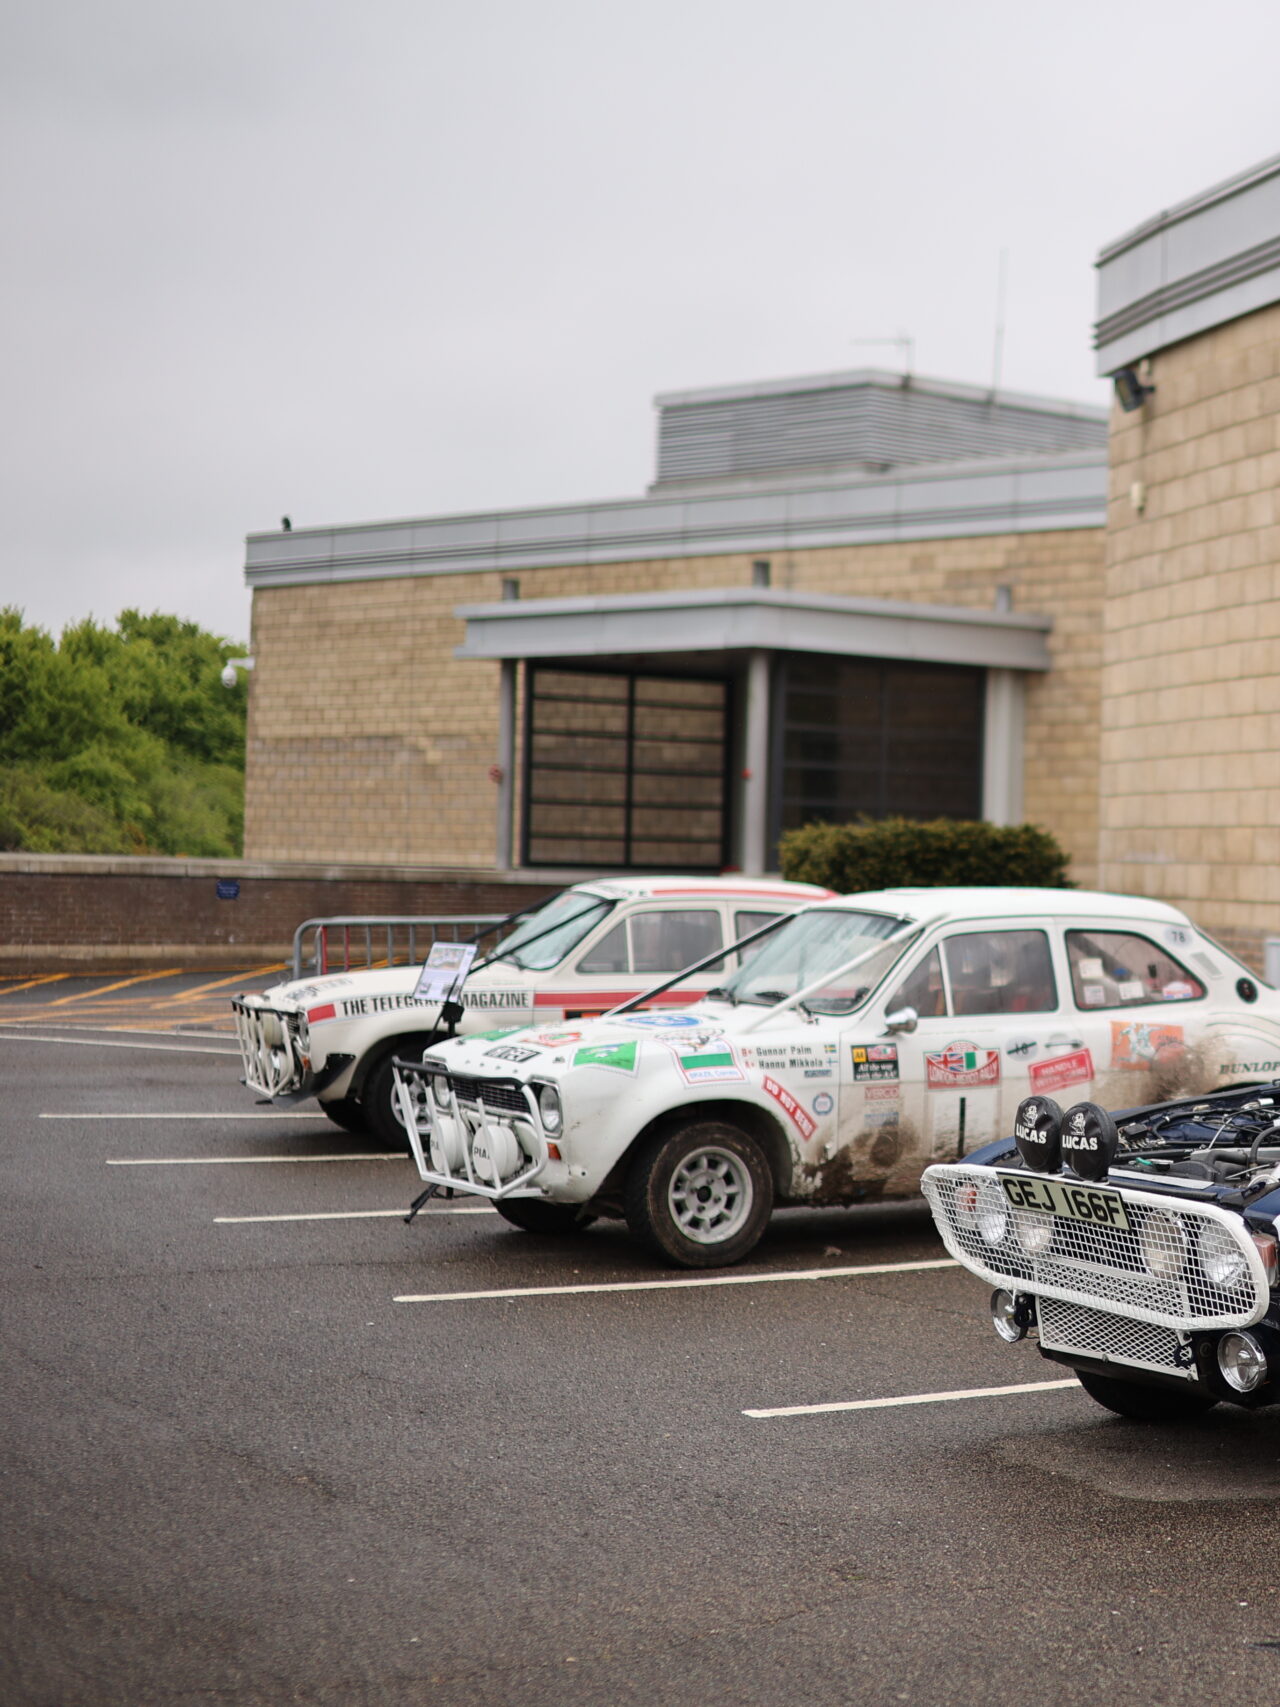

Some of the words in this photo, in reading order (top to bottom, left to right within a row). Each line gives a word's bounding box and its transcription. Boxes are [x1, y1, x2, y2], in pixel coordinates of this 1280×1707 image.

[341, 999, 369, 1017] THE
[460, 992, 528, 1009] MAGAZINE
[756, 1047, 787, 1056] Gunnar
[790, 1046, 812, 1055] Palm
[759, 1060, 786, 1069] Hannu
[789, 1058, 823, 1068] Mikkola
[858, 1063, 869, 1072] All
[869, 1063, 880, 1071] the
[881, 1064, 894, 1073] way
[1040, 1059, 1077, 1076] HANDLE
[766, 1078, 780, 1096] DO
[779, 1089, 798, 1113] NOT
[1016, 1123, 1047, 1144] LUCAS
[1062, 1135, 1098, 1151] LUCAS
[474, 1147, 490, 1160] PIA
[1002, 1178, 1057, 1212] GEJ
[1061, 1187, 1121, 1225] 166F
